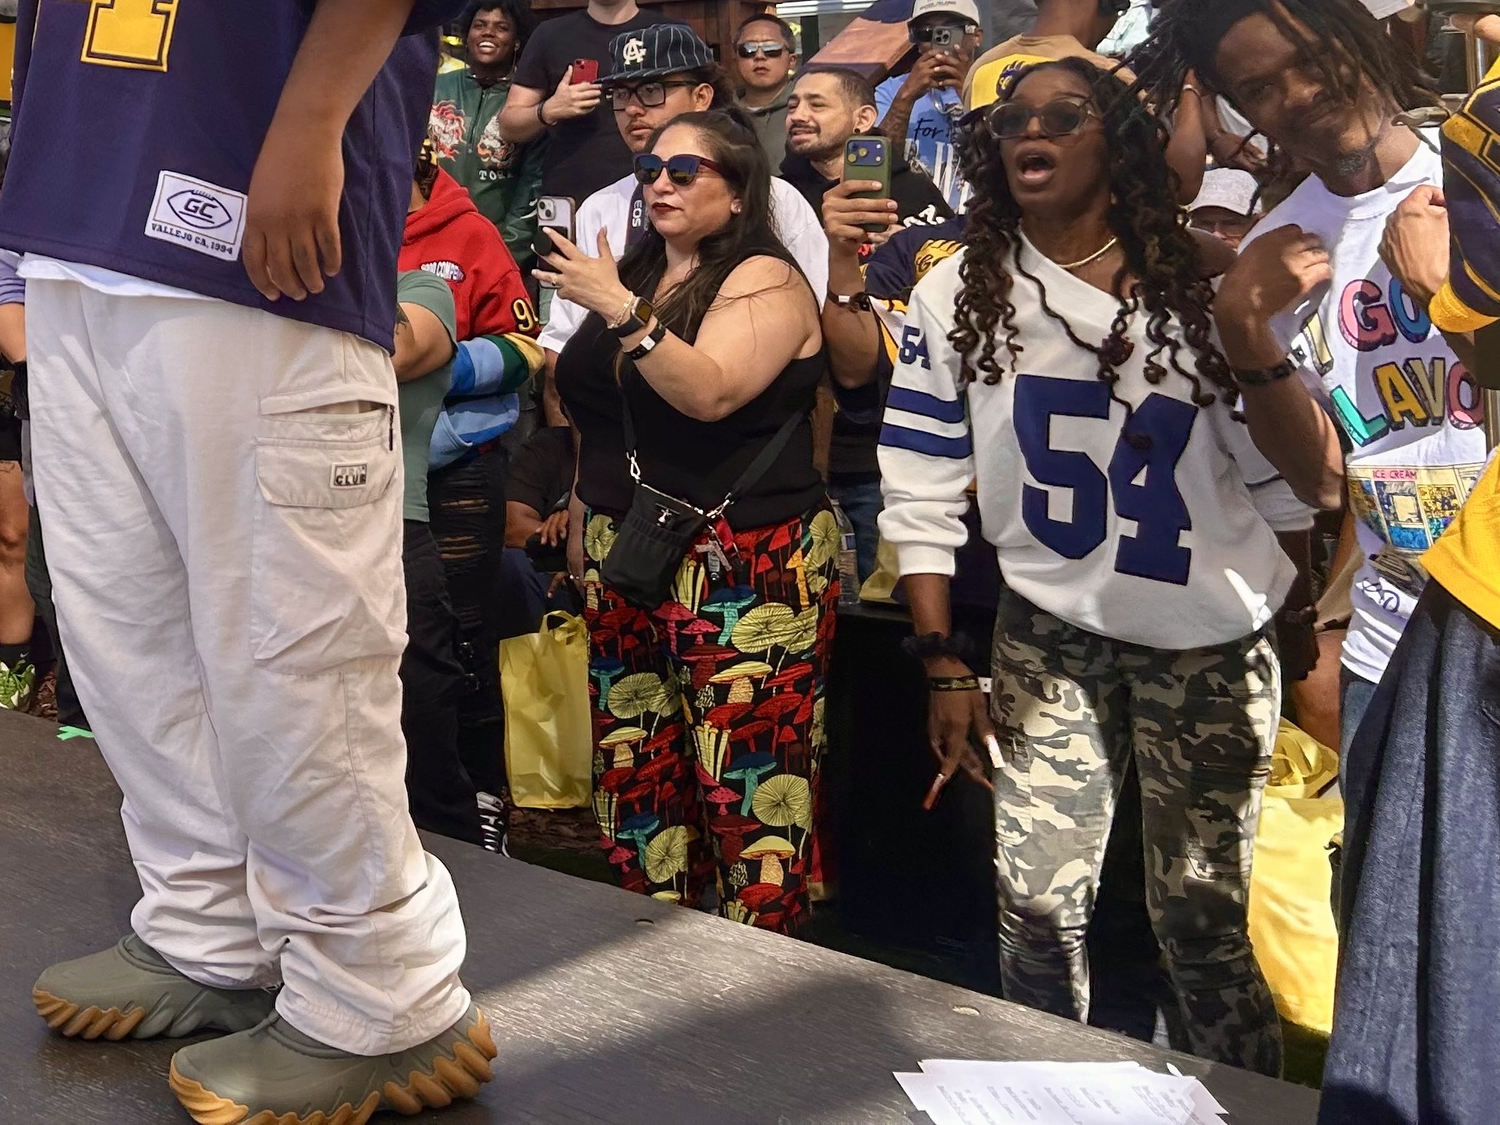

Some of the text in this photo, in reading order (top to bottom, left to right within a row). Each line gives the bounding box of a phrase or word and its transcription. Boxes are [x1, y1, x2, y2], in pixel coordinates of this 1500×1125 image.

[184, 197, 219, 219] GC
[632, 199, 643, 228] EOS
[152, 223, 234, 255] VALLEJO CA, 1994
[898, 325, 932, 371] 54
[335, 474, 367, 486] CLUB
[1013, 373, 1200, 587] 54
[1373, 469, 1417, 480] ICE CREAM
